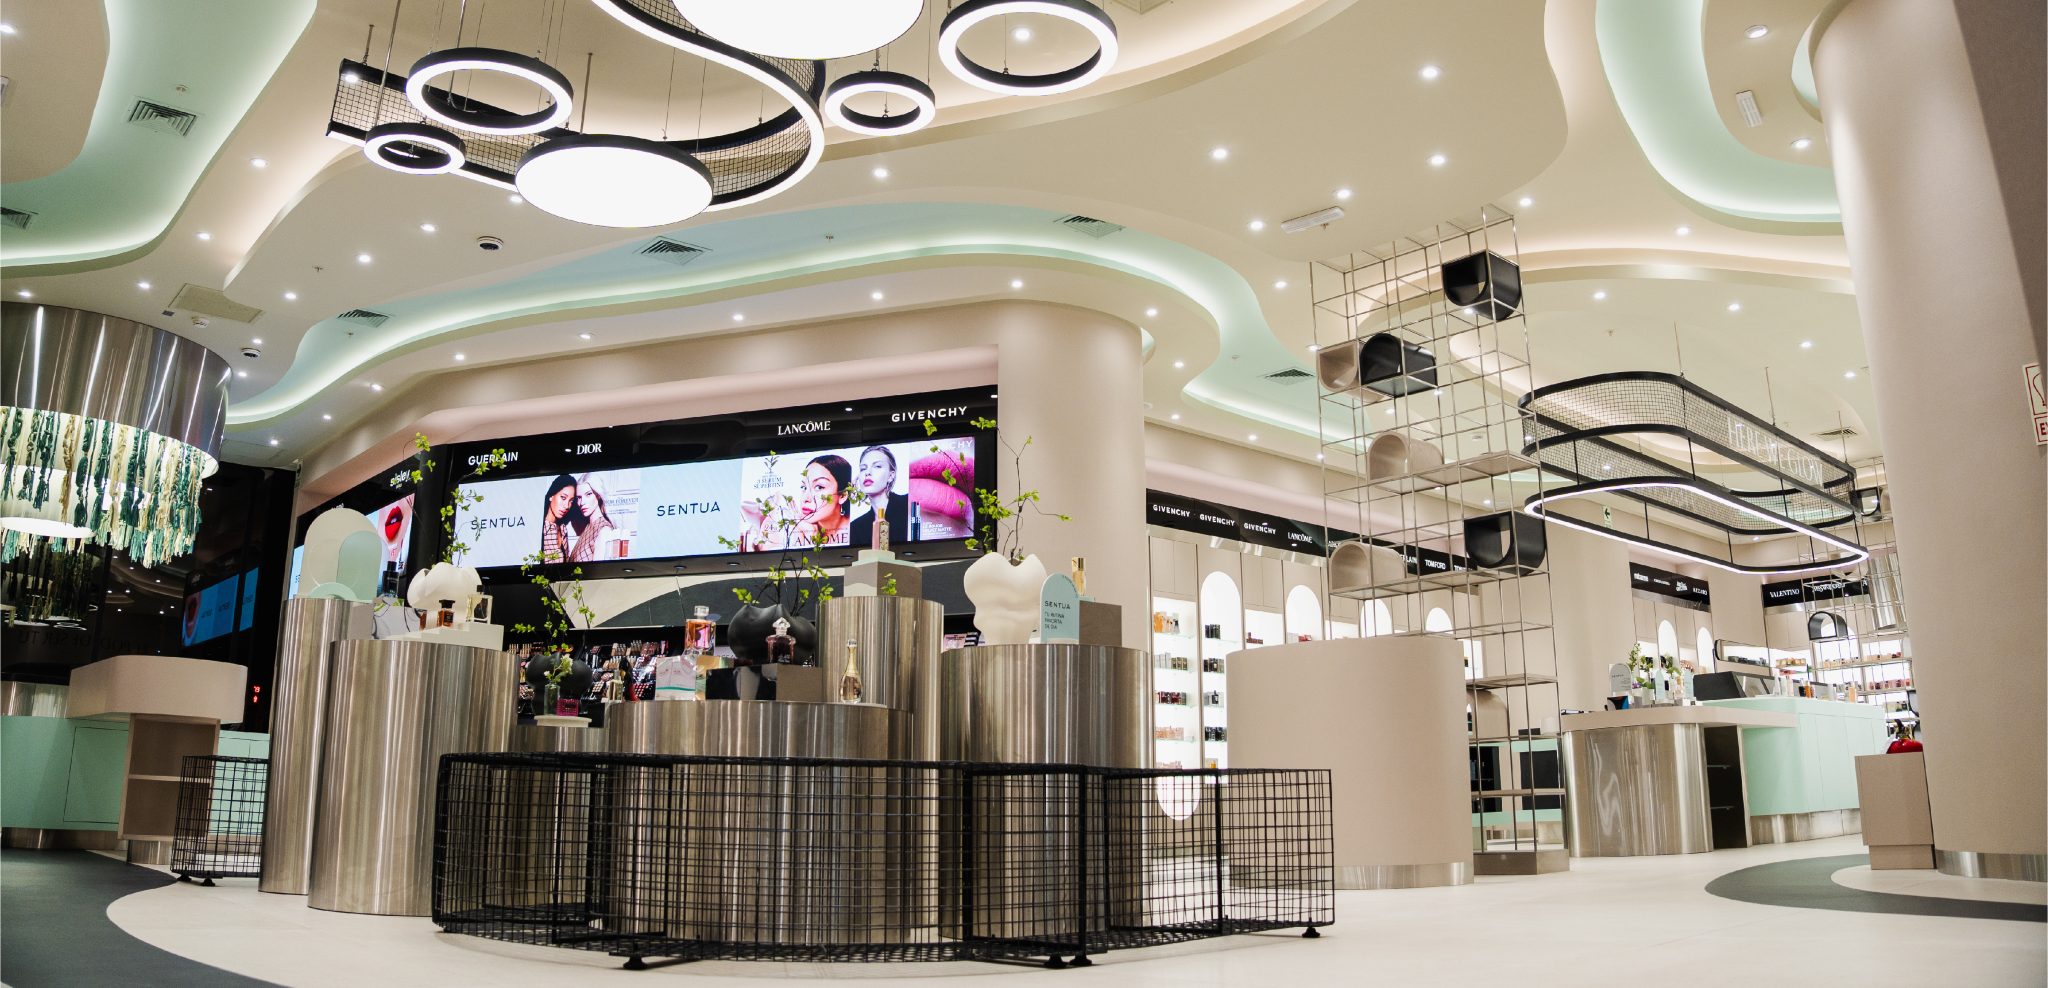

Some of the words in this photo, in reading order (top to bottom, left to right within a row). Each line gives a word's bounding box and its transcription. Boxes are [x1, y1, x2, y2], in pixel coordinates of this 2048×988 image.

[891, 406, 968, 423] GIVENCHY
[777, 420, 831, 436] LANCÔME
[576, 442, 602, 456] DIOR
[1787, 447, 1823, 487] GLOW
[656, 501, 721, 517] SENTUA
[1152, 504, 1191, 518] GIVENCHY
[470, 516, 526, 530] SENTUA
[1199, 513, 1236, 527] GIVENCHY
[1243, 522, 1277, 535] GIVENCHY
[1769, 588, 1800, 598] VALENTINO
[1044, 600, 1070, 610] SENTUA
